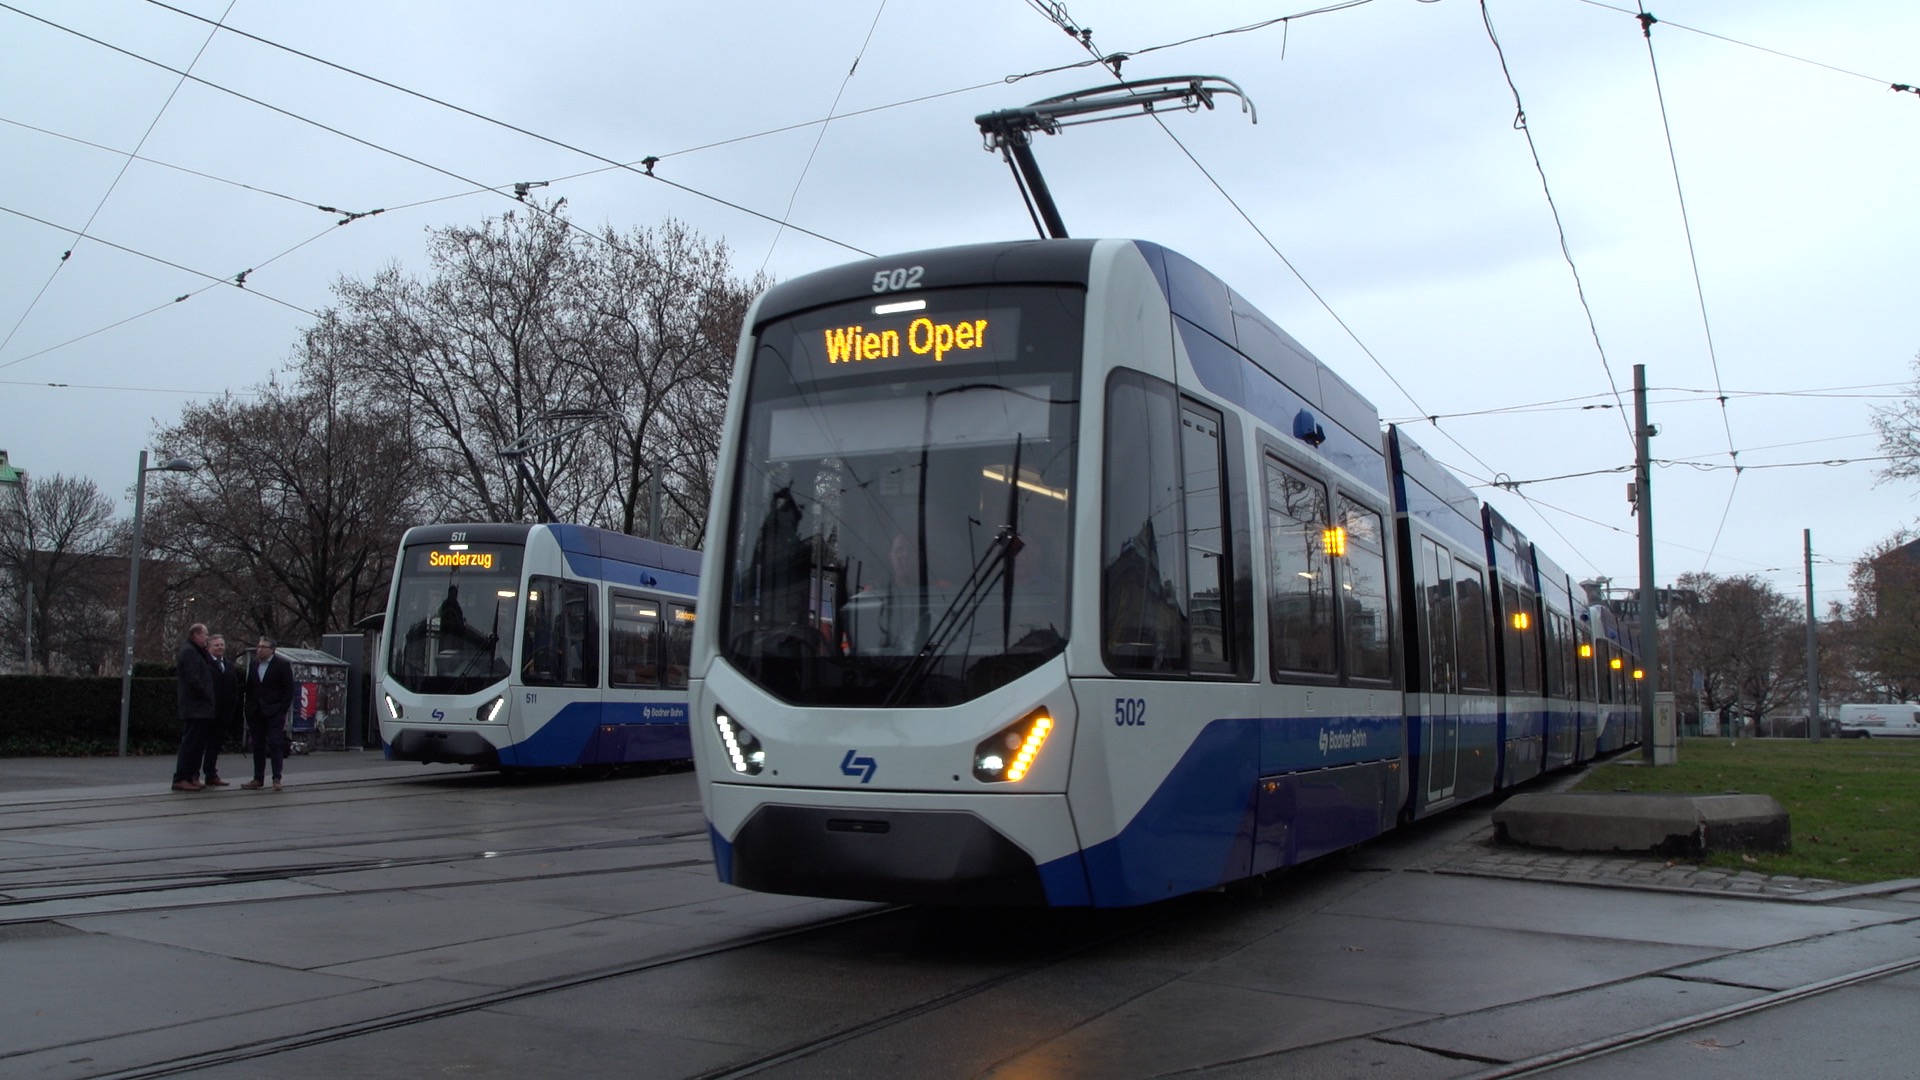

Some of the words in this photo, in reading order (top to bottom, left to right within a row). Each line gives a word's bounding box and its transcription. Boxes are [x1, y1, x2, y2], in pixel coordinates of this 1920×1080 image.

[872, 265, 925, 293] 502
[825, 325, 899, 364] Wien
[908, 317, 988, 362] Oper
[451, 531, 467, 542] 511
[430, 551, 492, 568] Sonderzug
[525, 693, 537, 704] 511
[651, 706, 670, 717] Badner
[670, 705, 684, 717] Bahn
[1115, 698, 1146, 726] 502
[1329, 730, 1351, 749] Badner
[1352, 728, 1367, 748] Bahn
